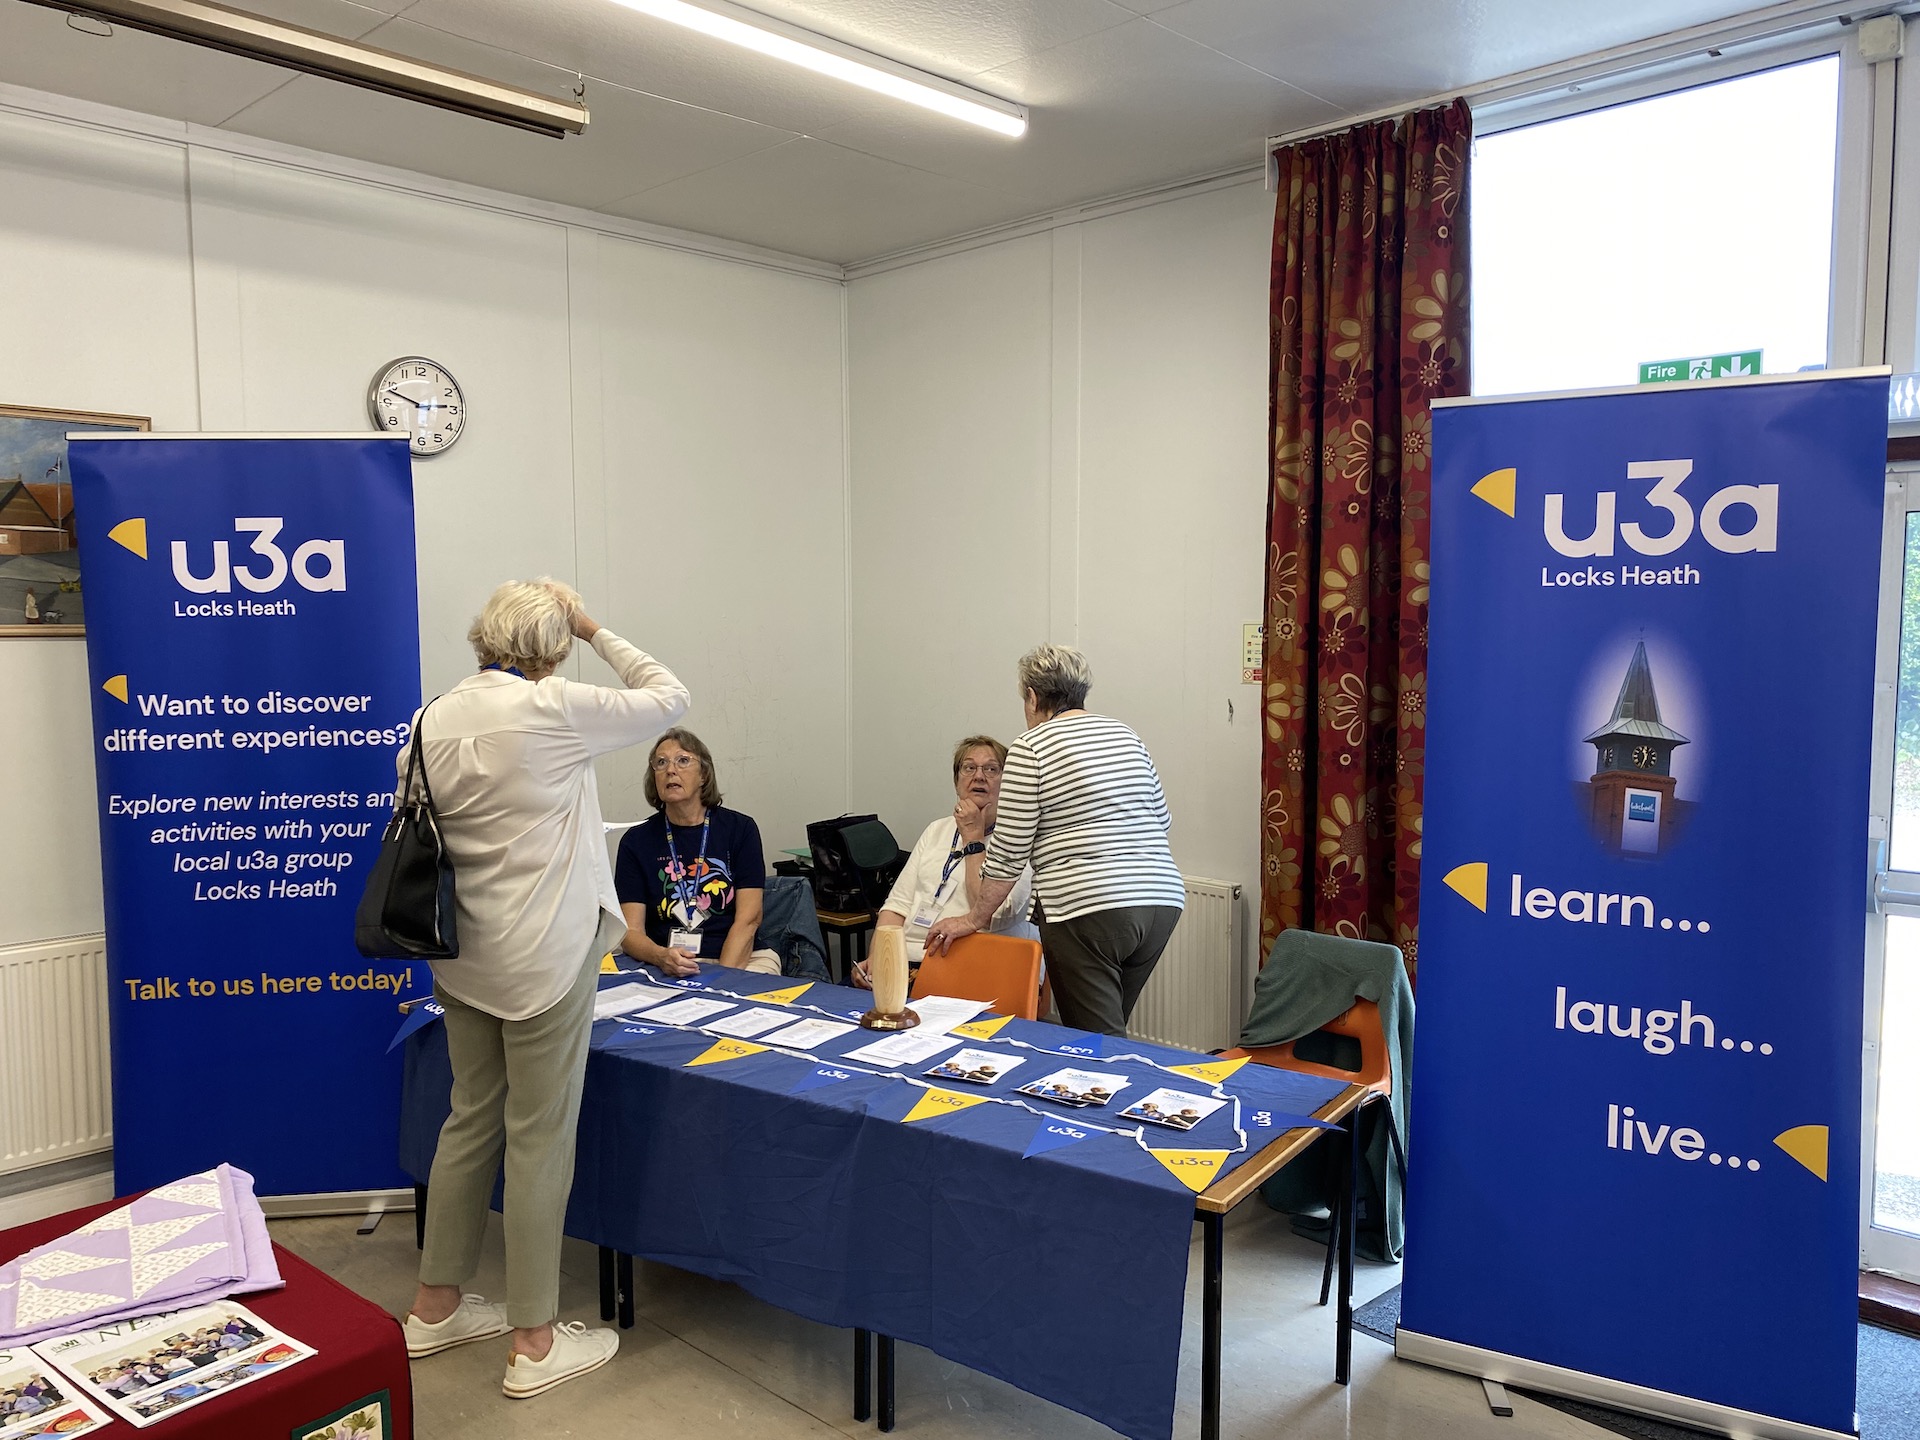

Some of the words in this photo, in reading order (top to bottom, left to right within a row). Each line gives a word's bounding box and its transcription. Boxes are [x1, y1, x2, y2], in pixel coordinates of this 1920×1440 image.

[401, 369, 408, 379] 11
[415, 366, 426, 377] 12
[1647, 365, 1677, 379] Fire
[444, 387, 453, 398] 2
[449, 405, 458, 415] 3
[388, 416, 398, 426] 8
[445, 422, 453, 431] 4
[417, 436, 426, 446] 6
[433, 433, 443, 443] 5
[1543, 458, 1780, 559] u3a
[170, 516, 347, 594] u3a
[1541, 565, 1615, 587] Locks
[1621, 563, 1700, 586] Heath
[174, 600, 234, 617] Locks
[237, 598, 296, 616] Heath
[137, 694, 215, 717] Want
[221, 694, 250, 715] to
[256, 691, 372, 714] discover
[103, 728, 225, 752] different
[231, 723, 411, 753] experiences?
[108, 793, 197, 820] Explore
[203, 797, 254, 812] new
[258, 790, 359, 810] interests
[365, 792, 394, 807] an
[150, 821, 257, 844] activities
[264, 819, 313, 840] with
[319, 823, 372, 843] your
[173, 850, 231, 873] local
[236, 850, 279, 870] u3a
[284, 852, 353, 874] group
[194, 879, 261, 901] Locks
[268, 877, 337, 899] Heath
[1510, 873, 1711, 933] learn...
[124, 976, 181, 1001] Talk
[187, 977, 216, 997] to
[223, 980, 255, 996] us
[261, 973, 323, 994] here
[328, 967, 413, 995] today!
[1555, 986, 1774, 1056] laugh...
[624, 1027, 656, 1035] u3a
[718, 1045, 748, 1055] u3a
[1059, 1045, 1094, 1054] u3a
[816, 1069, 851, 1080] u3a
[930, 1095, 966, 1107] u3a
[1252, 1111, 1272, 1127] u3a
[1047, 1125, 1087, 1139] u3a
[1607, 1103, 1761, 1172] live...
[1169, 1157, 1214, 1166] u3a
